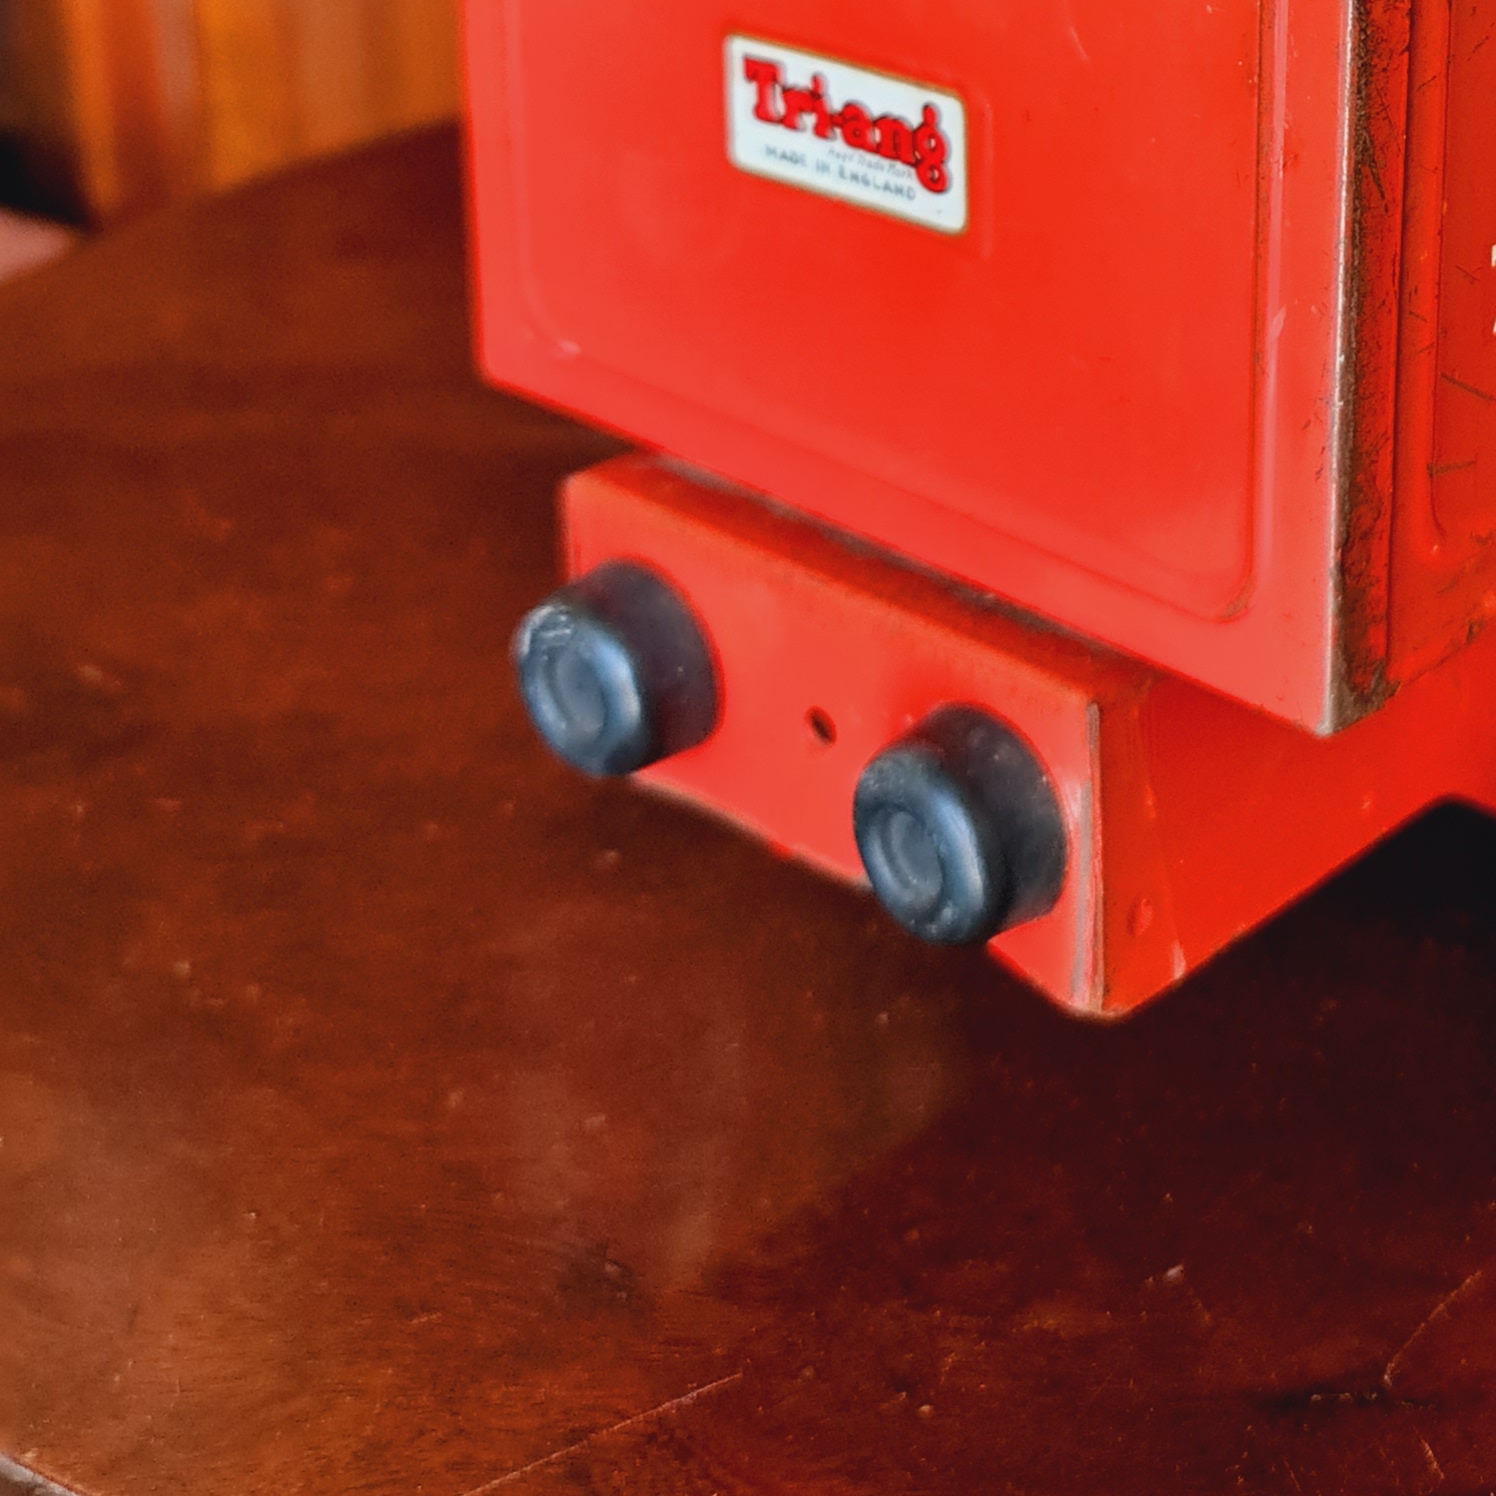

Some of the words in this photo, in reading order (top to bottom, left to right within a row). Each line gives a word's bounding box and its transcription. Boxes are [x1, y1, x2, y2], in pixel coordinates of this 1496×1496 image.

[743, 55, 950, 193] Tri-ang
[765, 144, 807, 168] MADE
[815, 158, 831, 175] IN
[838, 164, 917, 201] ENGLAND
